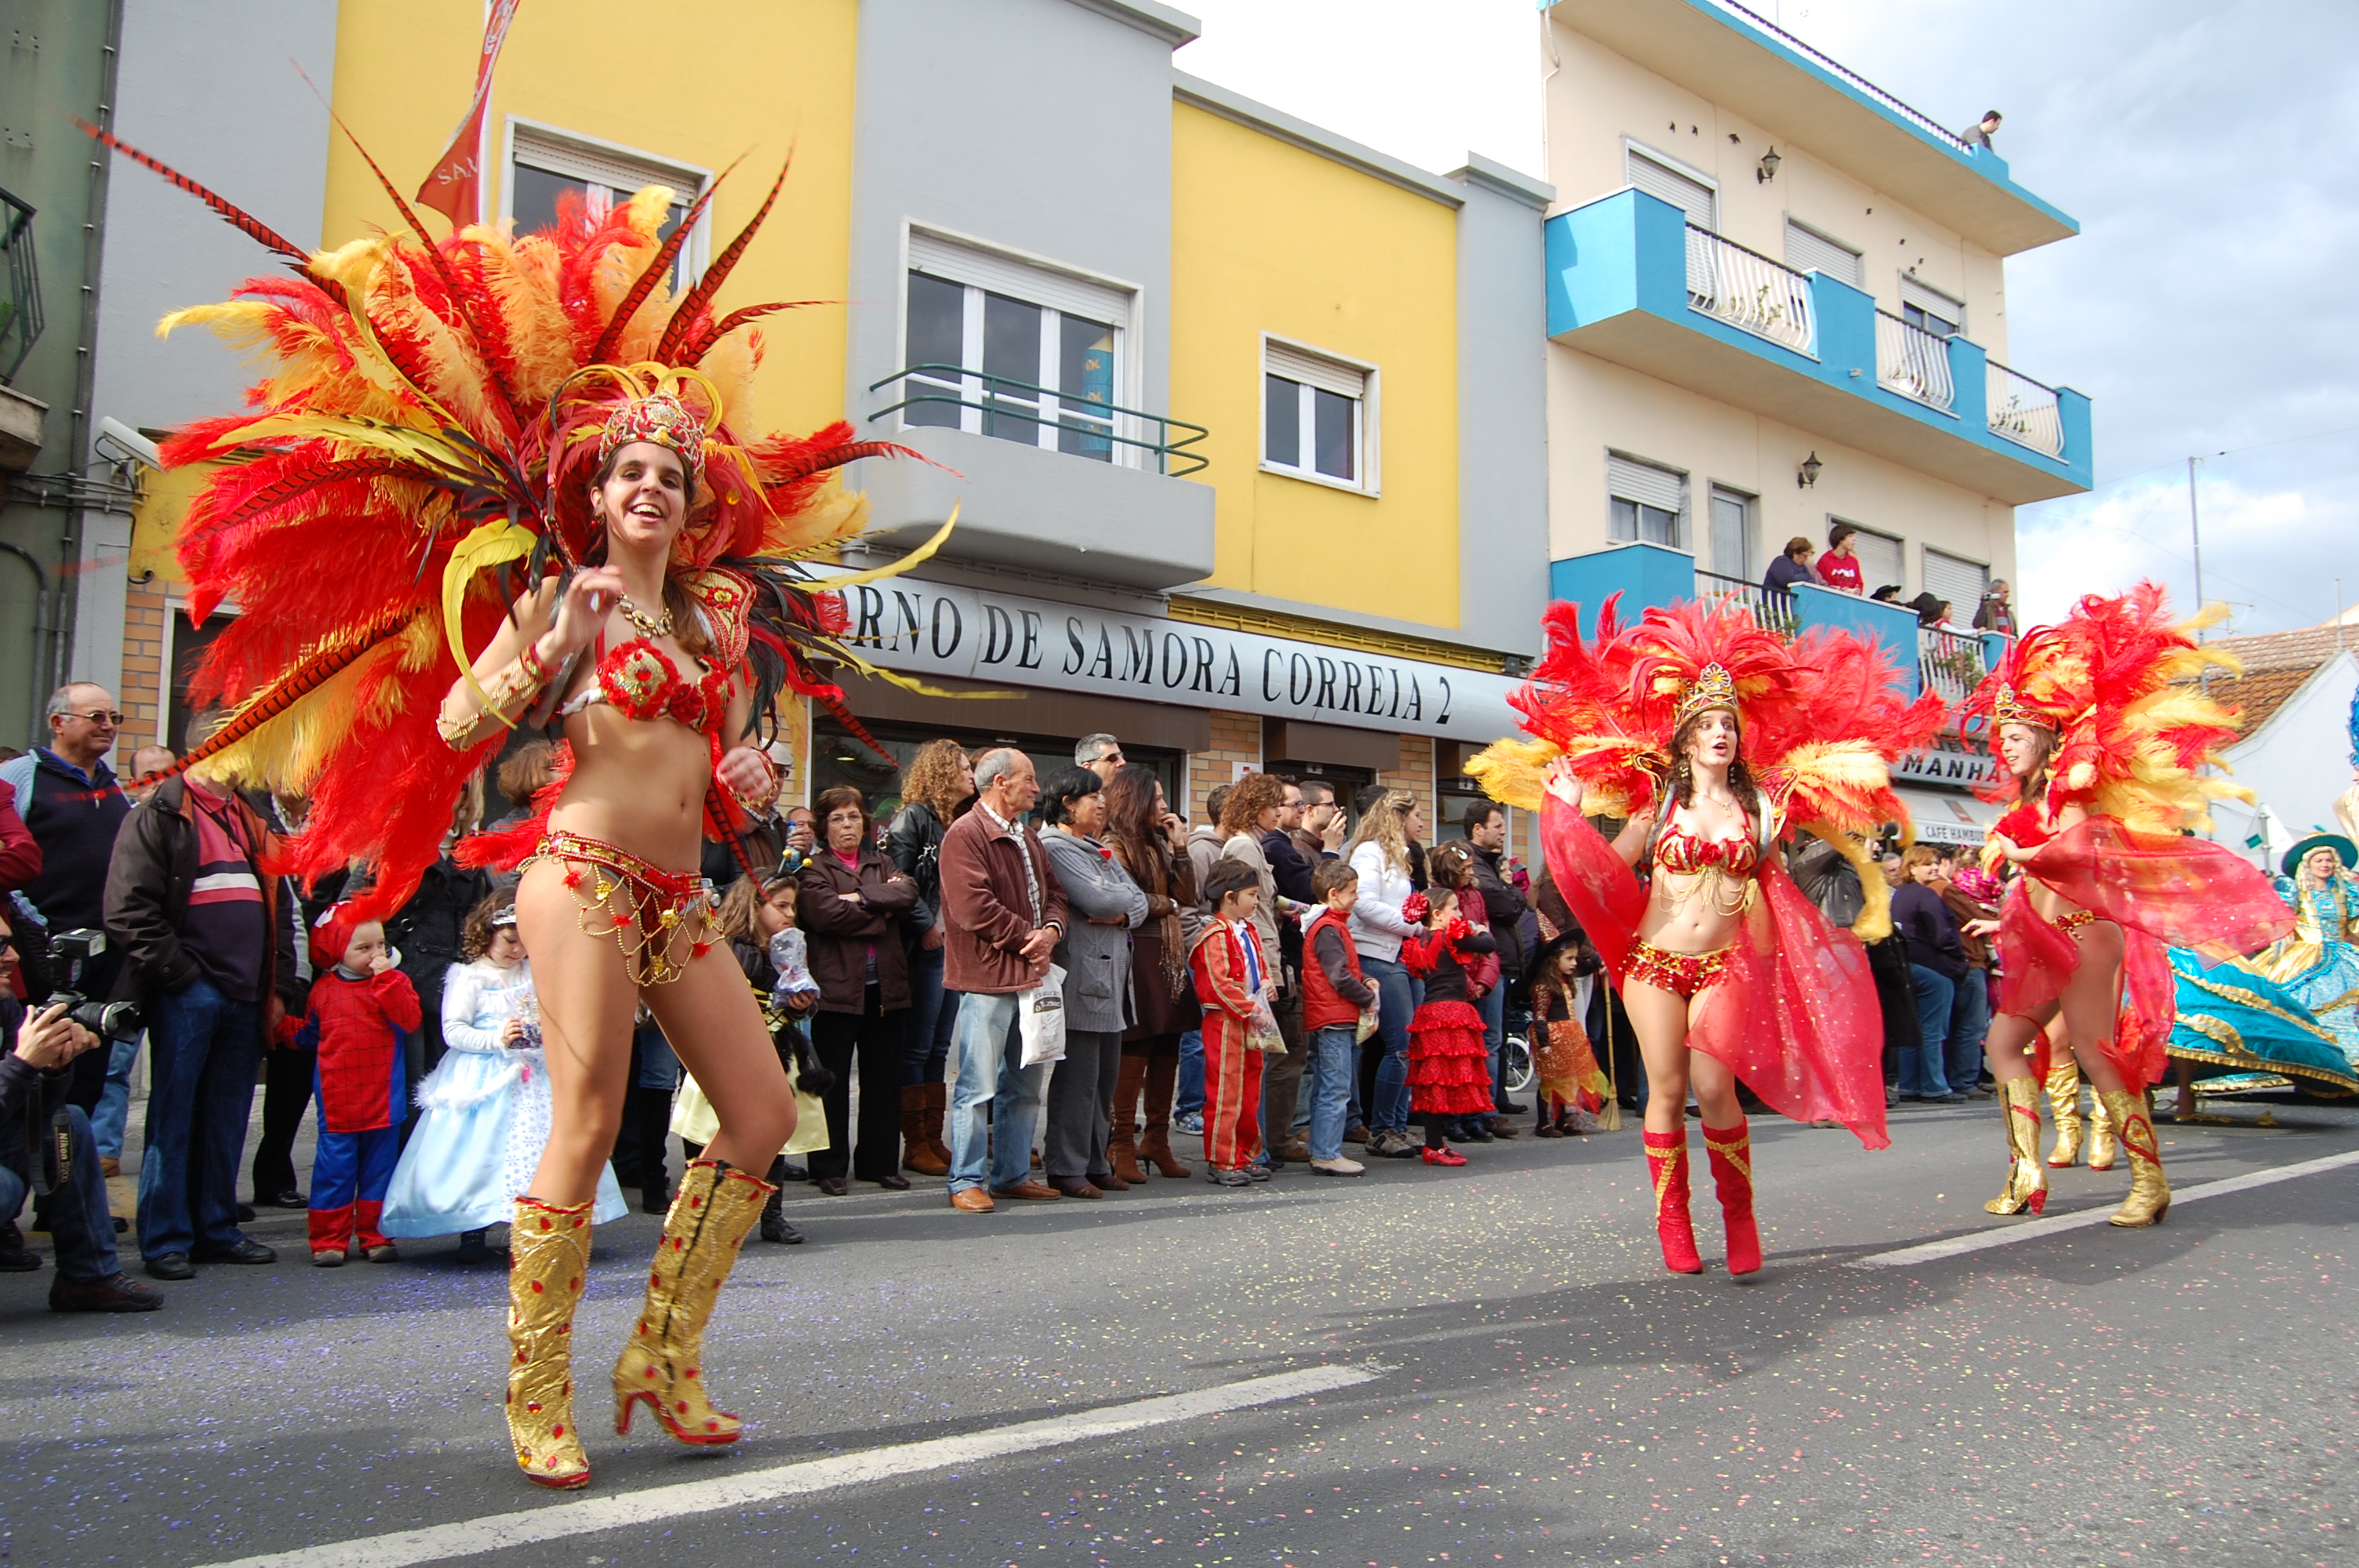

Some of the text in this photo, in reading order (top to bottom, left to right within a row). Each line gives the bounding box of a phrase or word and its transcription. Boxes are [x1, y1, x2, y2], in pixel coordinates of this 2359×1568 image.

[838, 585, 1452, 724] RNO DE SAMORA CORREIA 2
[1925, 825, 1948, 839] CAFÉ
[58, 1132, 69, 1160] Nikon
